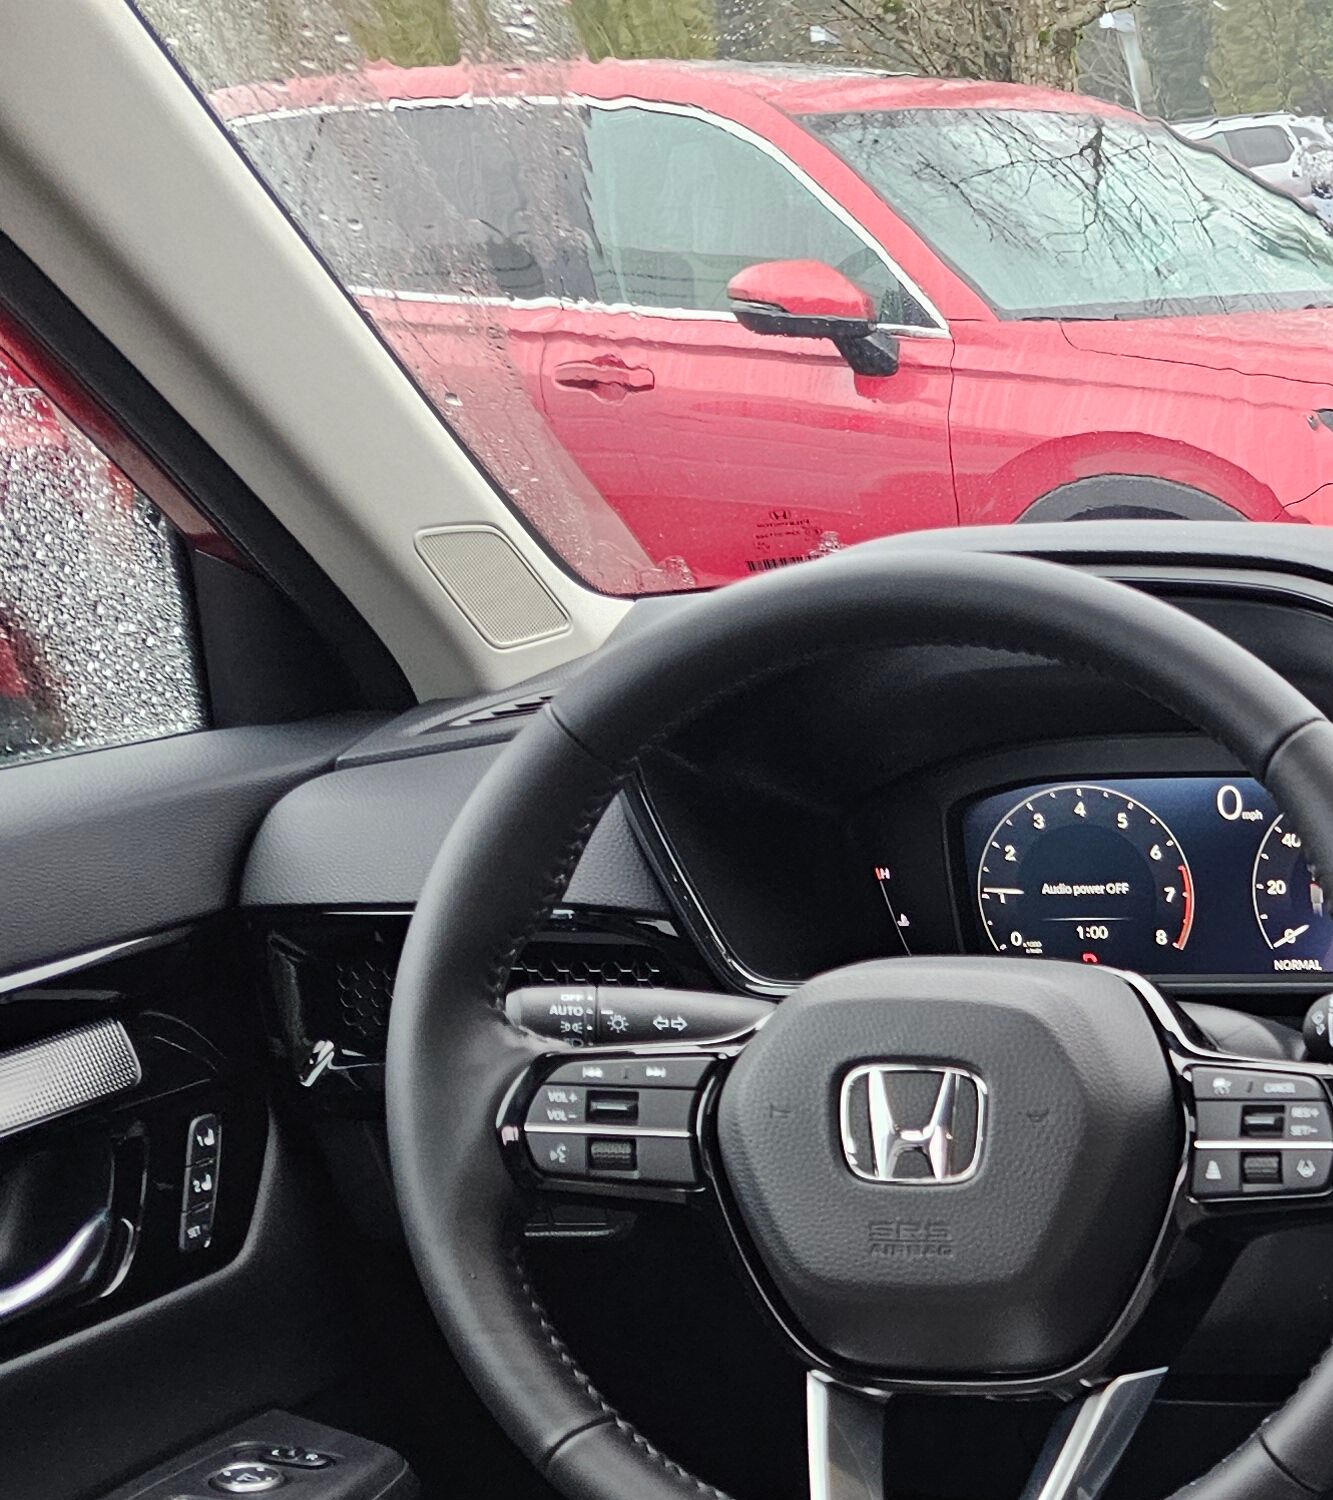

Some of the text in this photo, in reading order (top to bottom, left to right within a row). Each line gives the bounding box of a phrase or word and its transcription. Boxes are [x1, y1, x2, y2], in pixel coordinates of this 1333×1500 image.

[1073, 801, 1087, 818] 4
[1217, 785, 1264, 821] 0 mph
[1033, 813, 1046, 829] 3
[1117, 812, 1129, 829] 5
[1005, 845, 1018, 862] 2
[1150, 845, 1162, 861] 6
[1042, 883, 1130, 896] Audio power OFF
[1164, 886, 1176, 903] 7
[1267, 880, 1287, 895] 20
[1010, 931, 1023, 947] 0
[1076, 925, 1109, 940] 1:00
[1155, 929, 1168, 945] 8
[1274, 959, 1322, 971] NORMAL
[549, 1005, 584, 1017] AUTO
